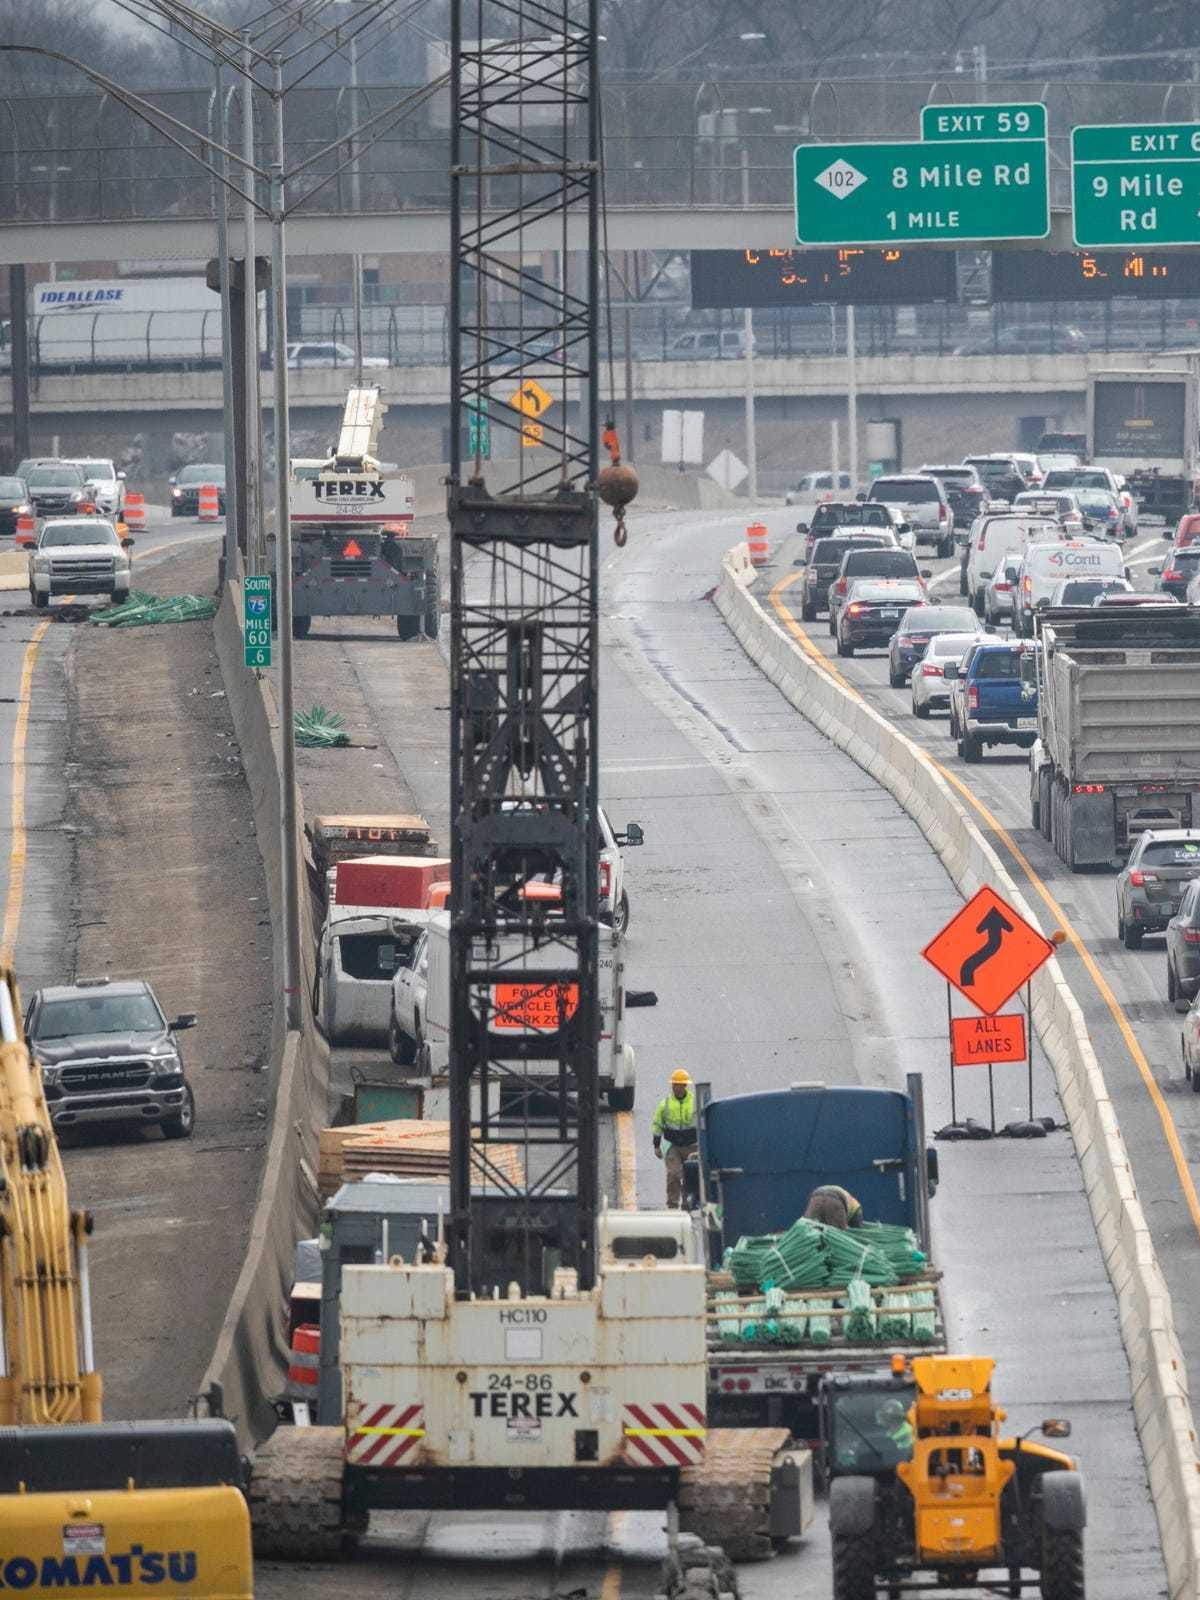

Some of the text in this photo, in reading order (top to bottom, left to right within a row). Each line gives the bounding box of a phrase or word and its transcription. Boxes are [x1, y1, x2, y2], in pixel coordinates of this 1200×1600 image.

[938, 112, 1030, 132] EXIT 59
[1130, 134, 1179, 152] EXIT
[827, 163, 1030, 188] 102 8 Mile Rd
[1092, 174, 1183, 198] 9 Mile
[886, 211, 960, 230] 1 MILE
[1120, 207, 1157, 230] Rd
[40, 290, 125, 303] IDEALEASE
[311, 481, 385, 498] TEREX
[1065, 552, 1101, 566] Conti
[245, 578, 270, 590] SOUTH
[248, 599, 265, 610] 75
[246, 619, 270, 630] MILE
[249, 631, 268, 645] 60
[252, 649, 265, 664] .6
[975, 1019, 1001, 1033] ALL
[967, 1038, 1012, 1054] LANES
[88, 1071, 124, 1081] RAM
[500, 1308, 547, 1324] HC110
[488, 1374, 553, 1391] 24-86
[937, 1388, 972, 1400] JCB
[470, 1392, 579, 1418] TEREX
[0, 1543, 197, 1590] OMATSU
